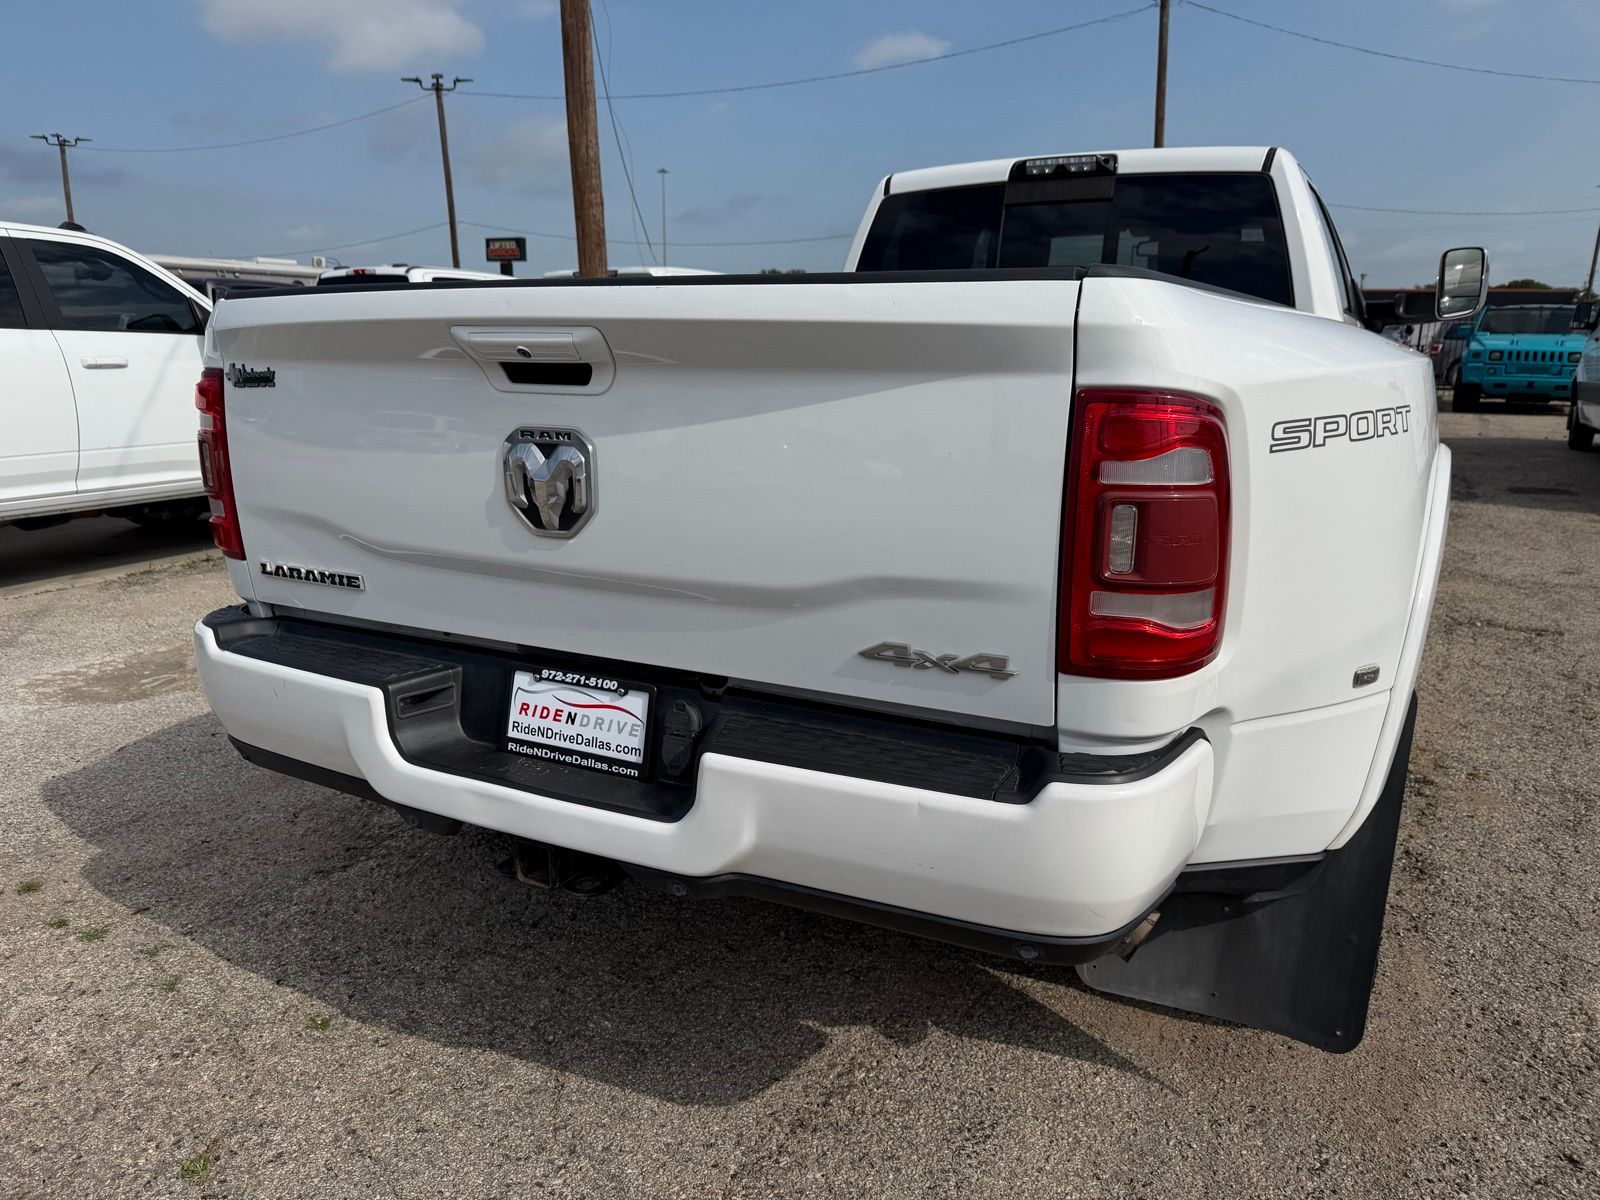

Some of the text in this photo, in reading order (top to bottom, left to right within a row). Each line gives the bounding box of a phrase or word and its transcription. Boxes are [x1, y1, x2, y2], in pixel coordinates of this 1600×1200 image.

[518, 430, 572, 441] RAM
[1269, 404, 1411, 454] SPORT
[259, 561, 363, 589] LARAMIE
[541, 669, 618, 691] 972-271-5100
[511, 721, 642, 758] RideNDriveDallas.com
[507, 742, 639, 777] RideNDriveDallas.com
